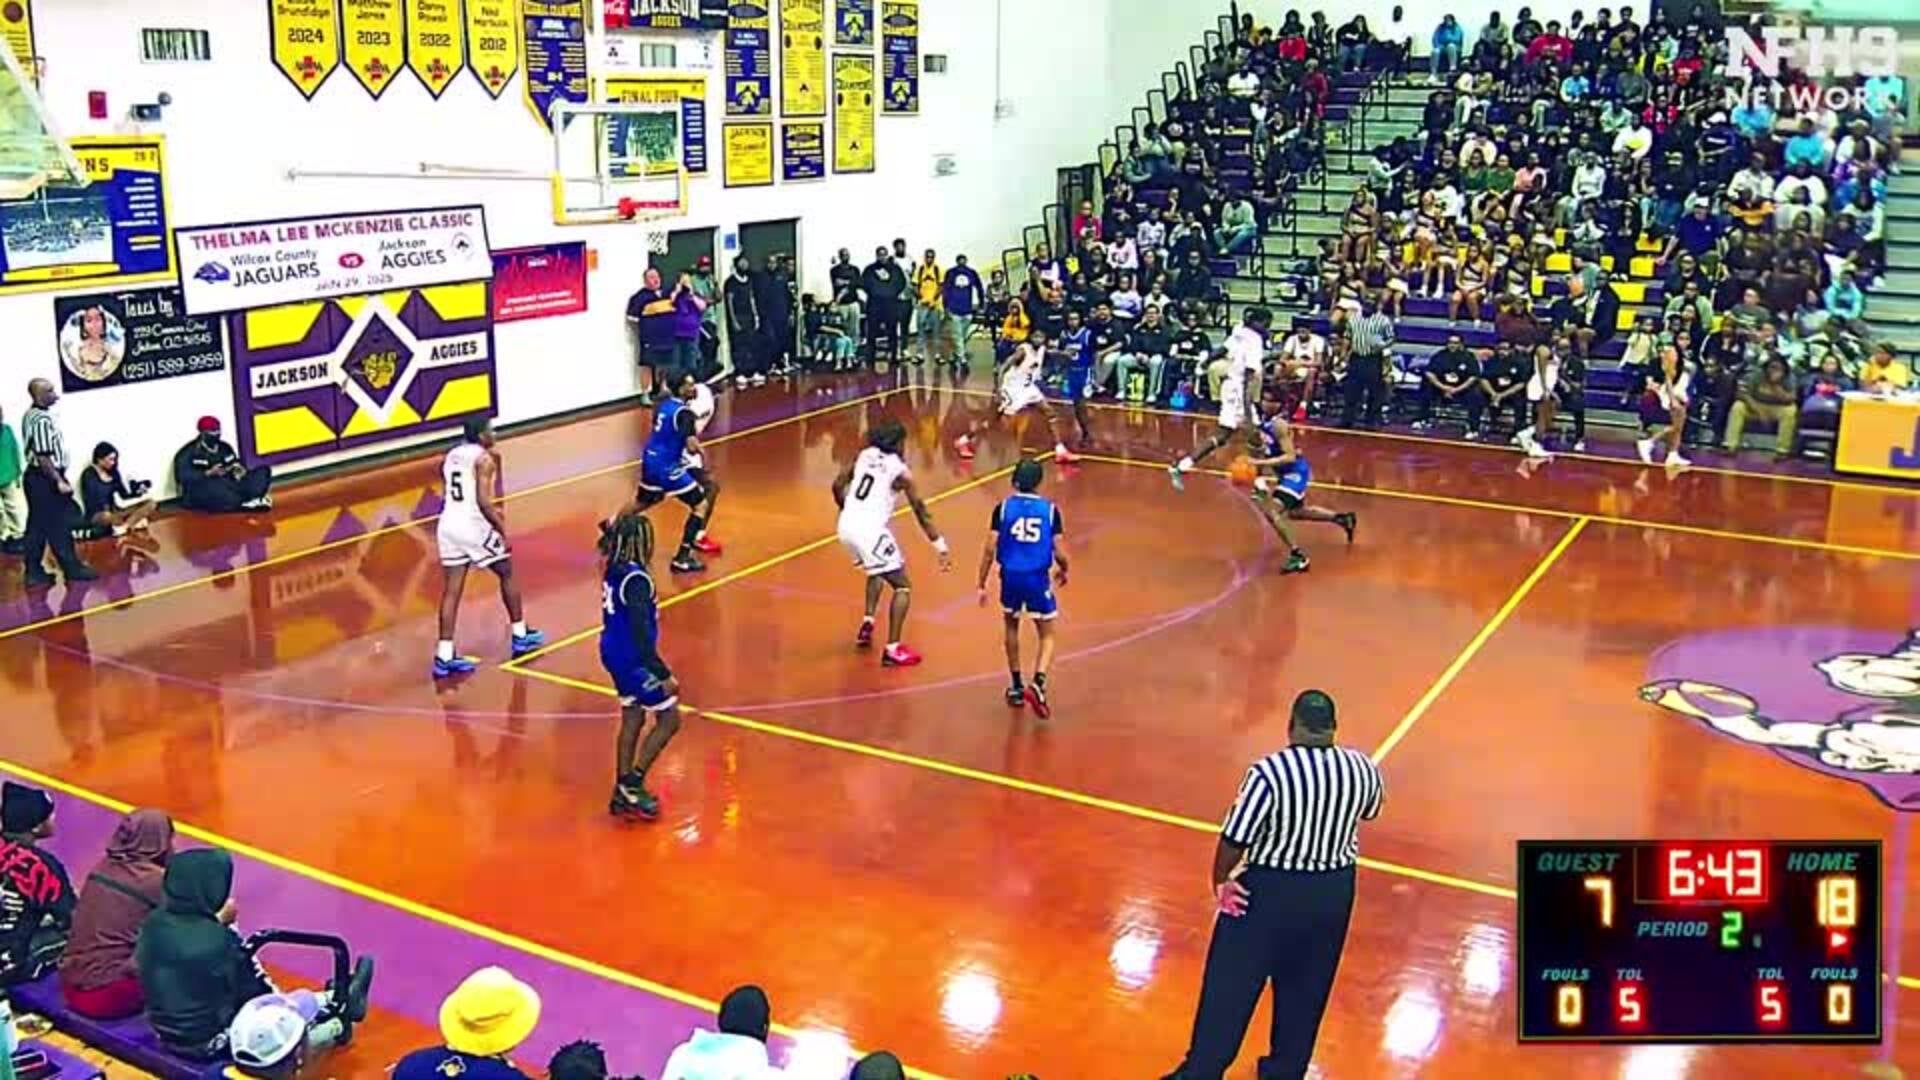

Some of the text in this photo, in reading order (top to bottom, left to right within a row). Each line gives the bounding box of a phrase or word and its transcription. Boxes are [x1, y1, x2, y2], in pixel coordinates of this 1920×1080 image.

[630, 0, 700, 20] JACKSON
[288, 27, 324, 43] 2024
[356, 30, 391, 46] 2023
[419, 33, 451, 47] 2022
[479, 37, 507, 51] 2012
[190, 212, 473, 251] THELMA LEE MCKENZIE CLASSIC
[275, 249, 317, 264] County
[381, 249, 447, 270] AGGIES
[233, 261, 321, 288] JAGUARS
[430, 341, 478, 361] AGGIES
[256, 362, 329, 388] JACKSON
[450, 471, 464, 501] 5
[855, 473, 875, 501] 0
[1011, 517, 1042, 543] 45
